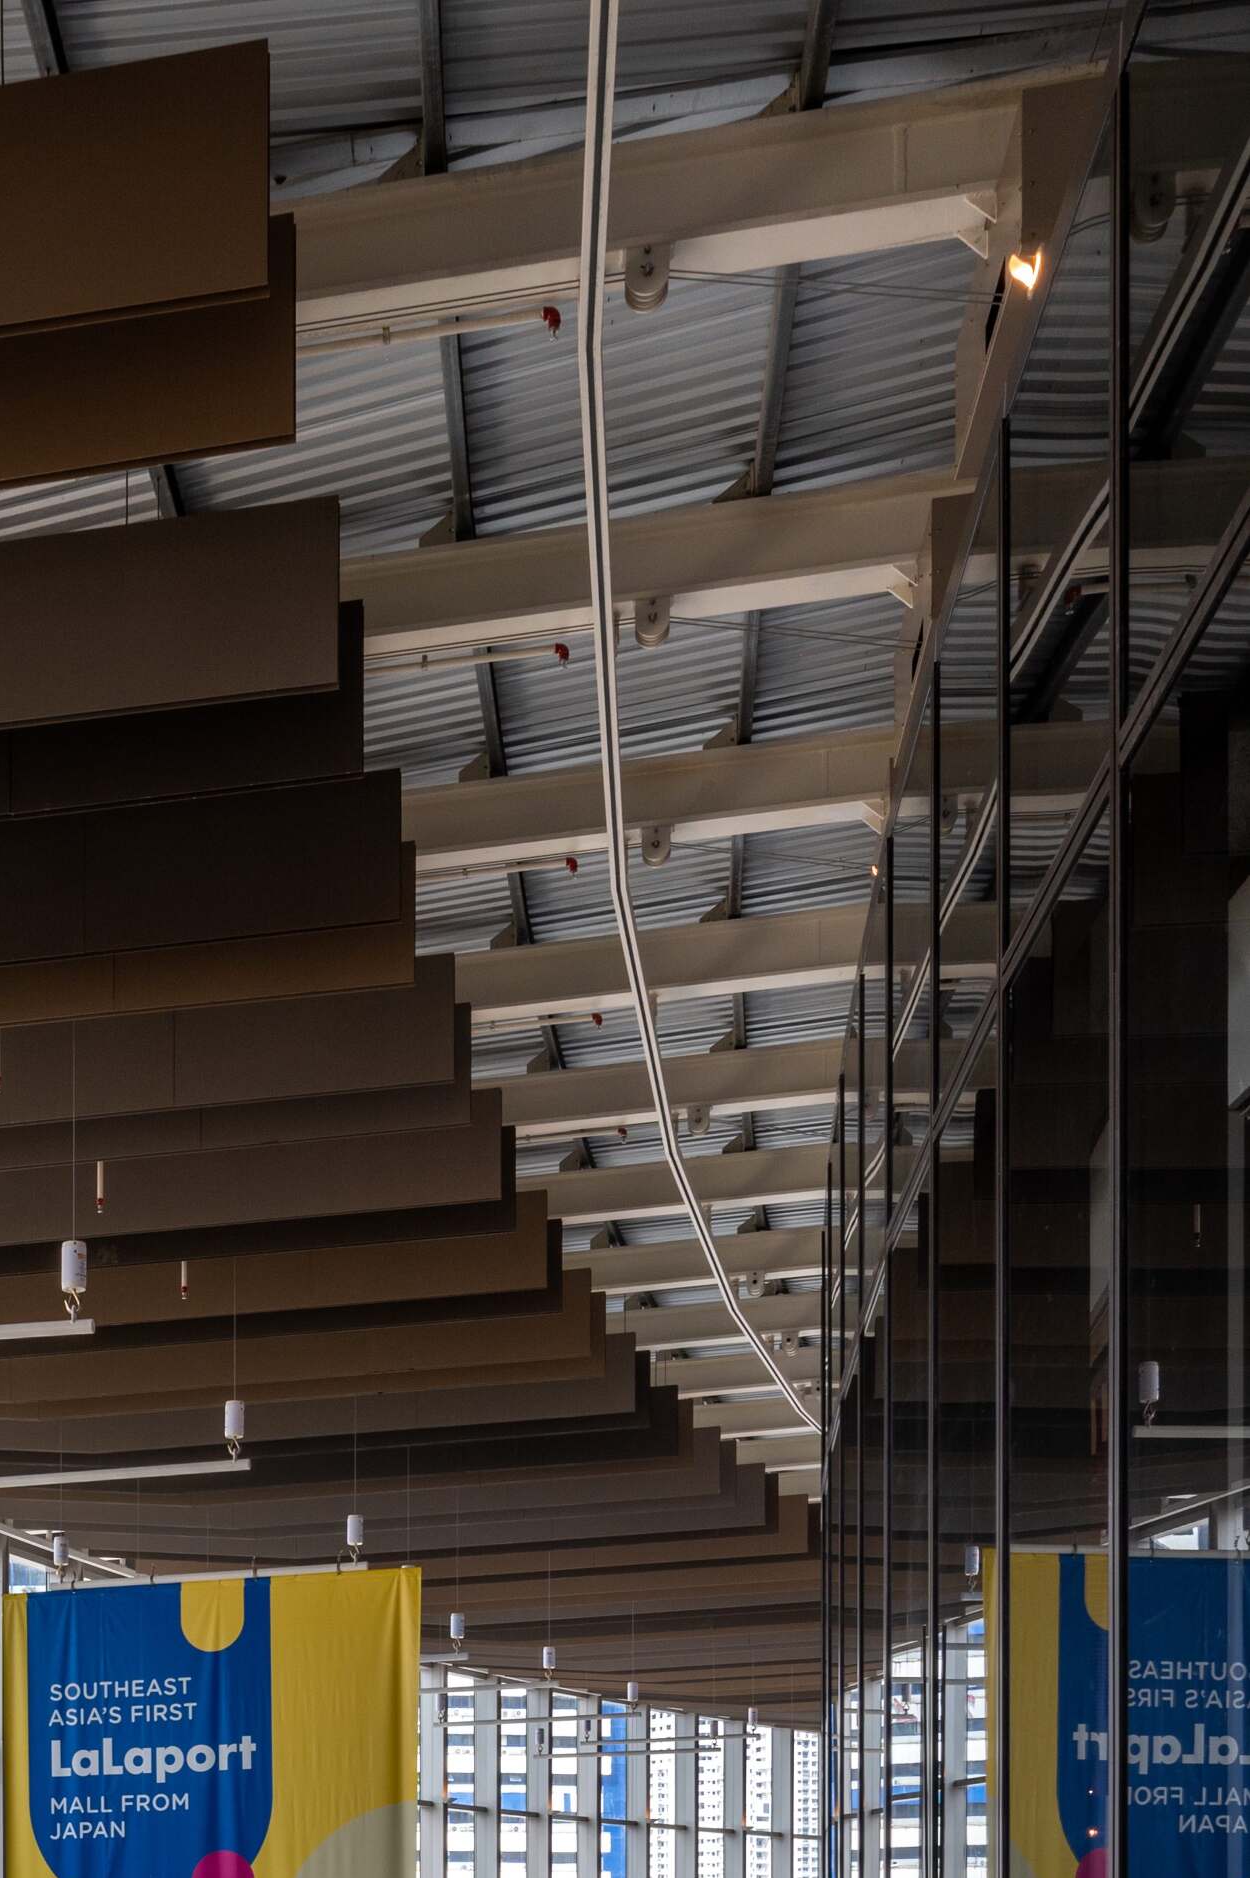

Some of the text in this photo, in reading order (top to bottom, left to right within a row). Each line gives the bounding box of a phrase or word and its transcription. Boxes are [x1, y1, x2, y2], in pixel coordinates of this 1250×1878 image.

[50, 1676, 192, 1701] SOUTHEAST
[48, 1702, 197, 1727] ASIA'S FIRST
[51, 1735, 257, 1784] LaLaport
[50, 1792, 189, 1815] MALL FROM
[50, 1820, 126, 1840] JAPAN
